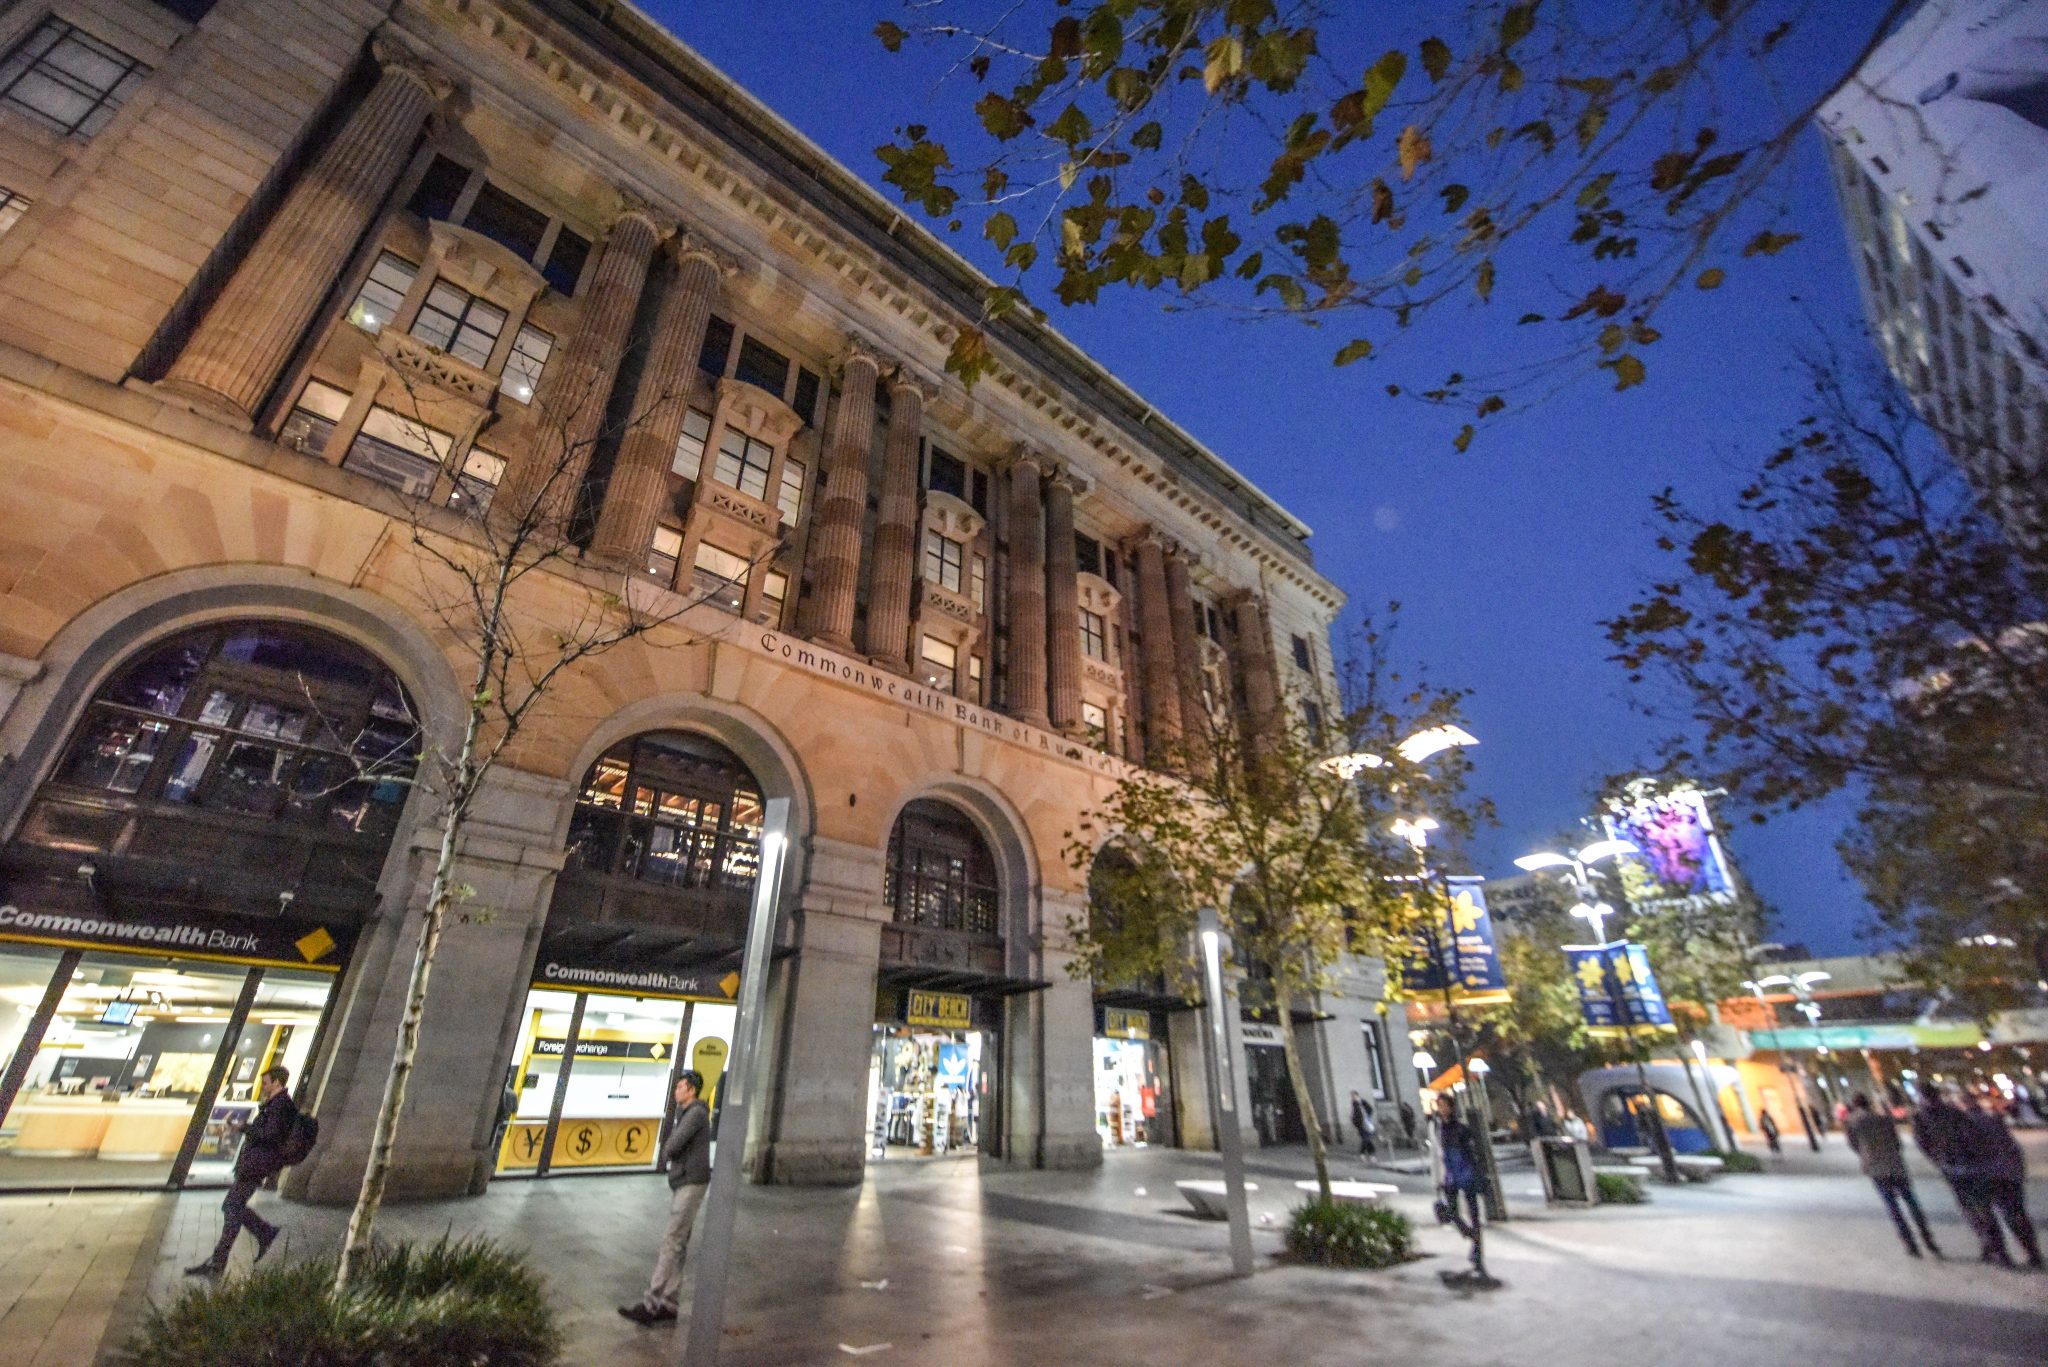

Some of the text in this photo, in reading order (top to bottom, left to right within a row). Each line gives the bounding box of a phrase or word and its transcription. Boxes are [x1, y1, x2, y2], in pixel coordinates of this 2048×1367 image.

[761, 633, 944, 712] Commonwealth
[956, 703, 1002, 734] Bank
[1013, 727, 1029, 743] of
[538, 1040, 608, 1055] Foreig xchange
[576, 1127, 593, 1156] $
[624, 1126, 641, 1153] £
